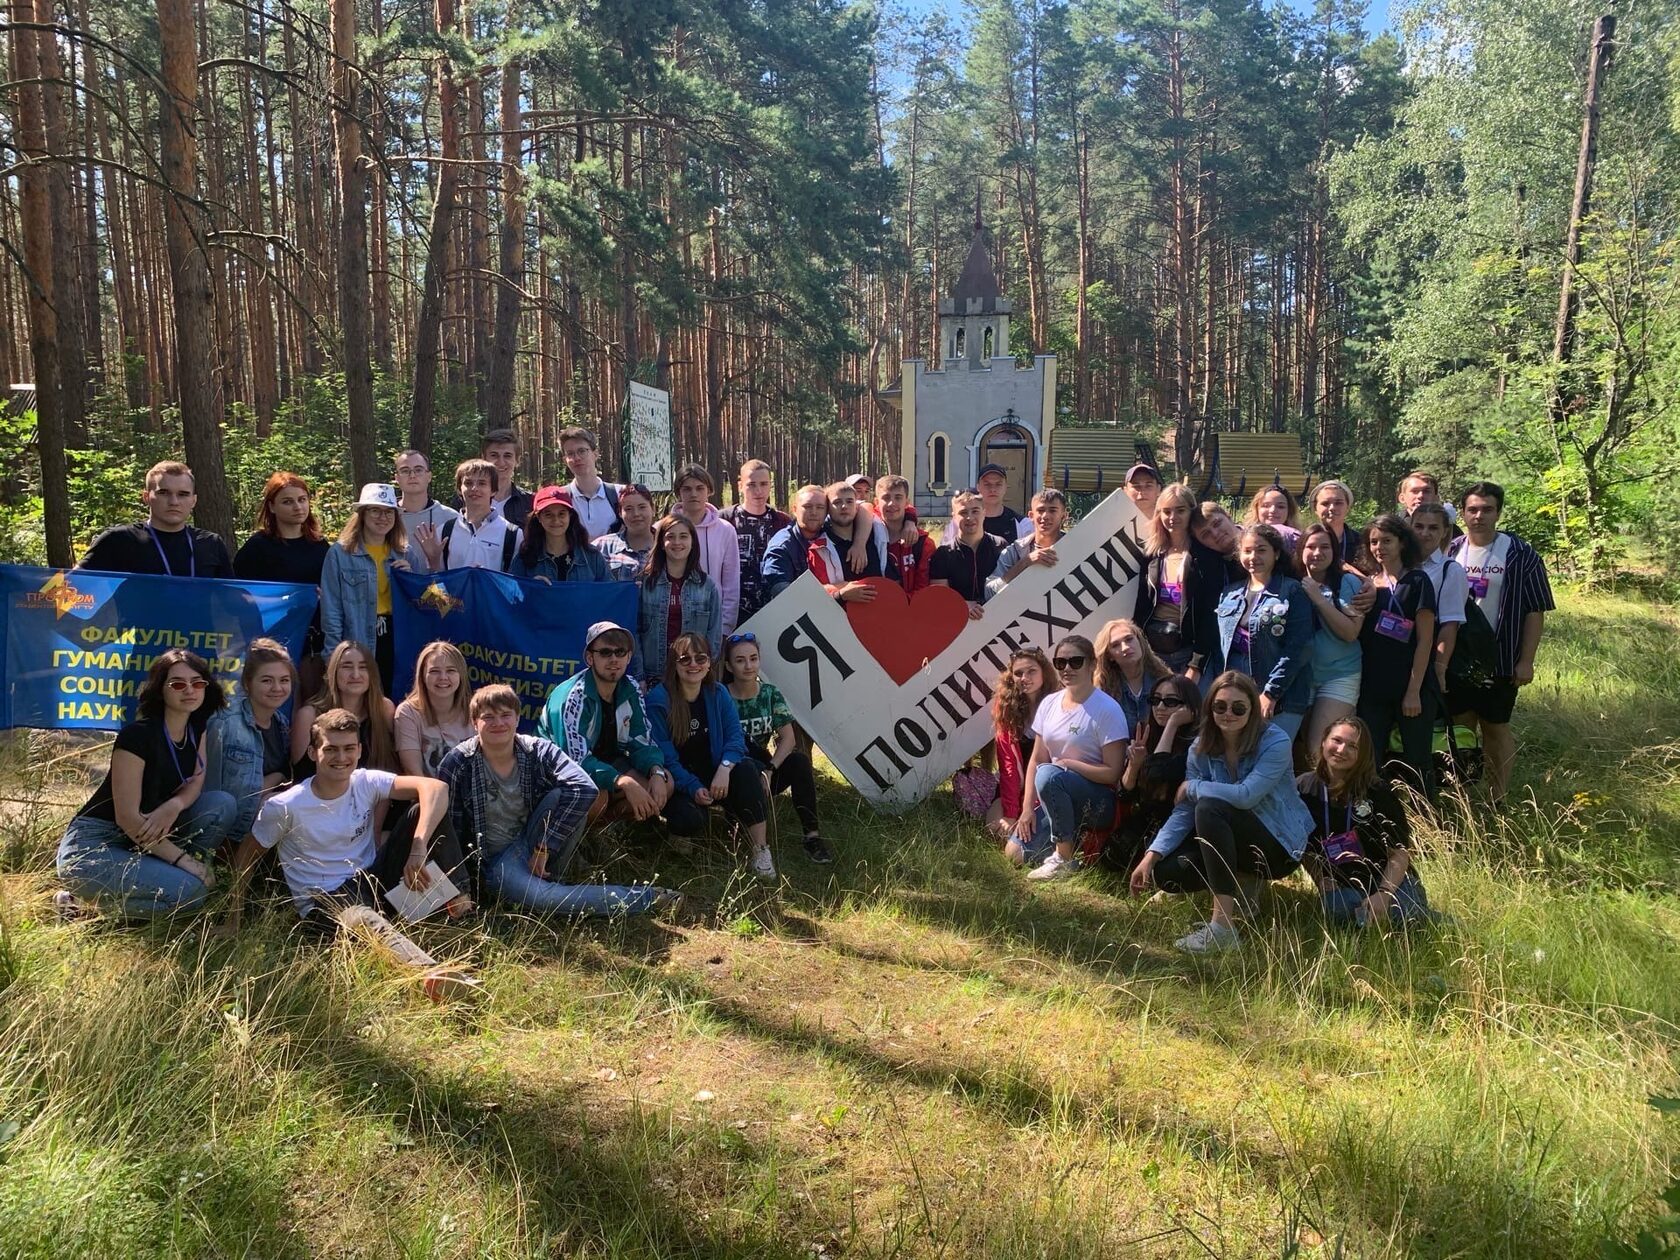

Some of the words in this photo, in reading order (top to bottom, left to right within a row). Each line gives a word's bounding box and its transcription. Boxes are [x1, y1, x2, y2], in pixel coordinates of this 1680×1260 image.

[80, 626, 234, 649] ФАКУЛЬТЕТ
[458, 641, 580, 677] ФАКУЛЬТЕТ
[777, 612, 855, 710] Я
[58, 702, 127, 722] НАУК
